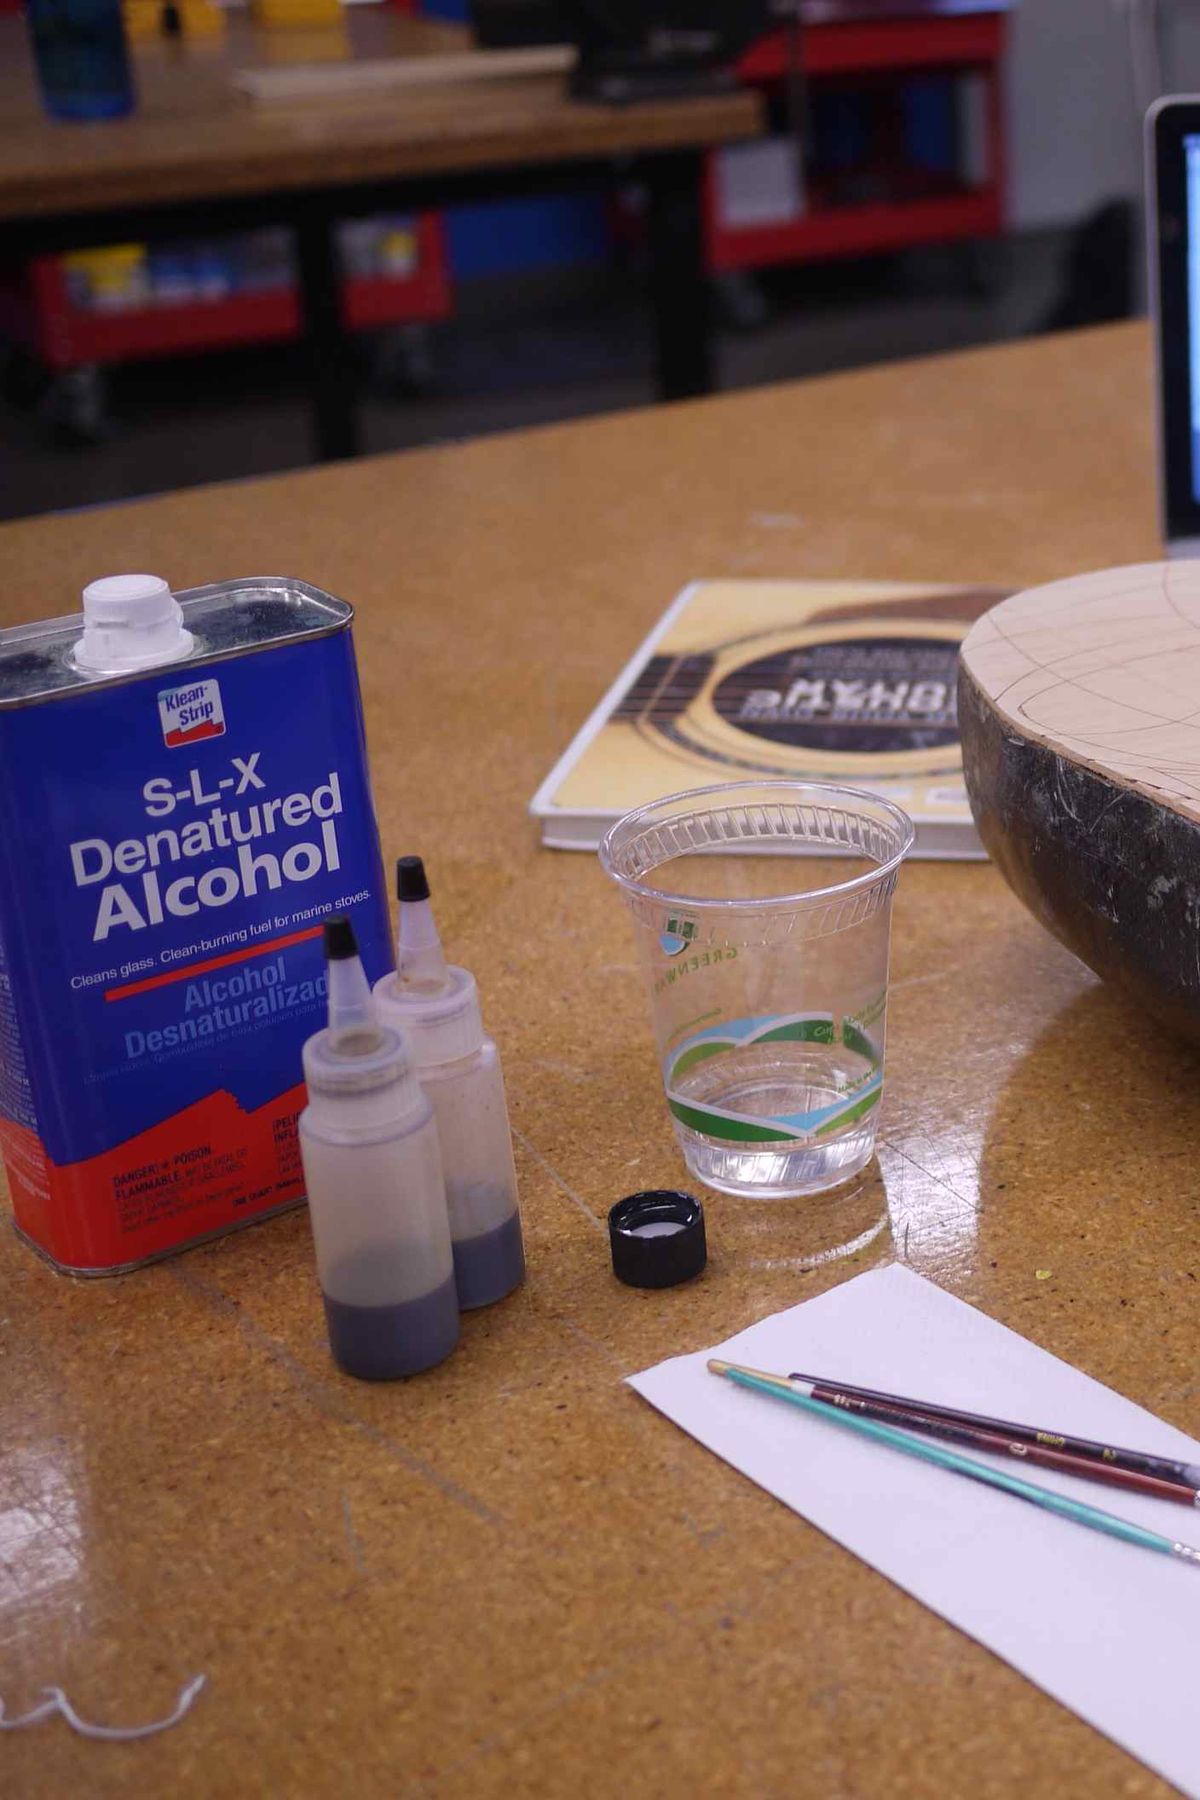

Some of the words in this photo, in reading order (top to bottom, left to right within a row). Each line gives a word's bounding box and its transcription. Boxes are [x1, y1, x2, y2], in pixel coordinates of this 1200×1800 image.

[165, 685, 208, 712] Klean-
[179, 701, 214, 726] Strip
[142, 751, 266, 817] S-L-X
[69, 771, 344, 887] Denatured
[92, 818, 341, 942] Alcohol
[70, 968, 117, 990] Cleans
[120, 957, 157, 979] glass.
[160, 929, 248, 964] Clean-burning
[250, 917, 273, 938] fuel
[274, 913, 290, 929] for
[292, 900, 332, 921] marine
[335, 888, 371, 910] stoves.
[124, 970, 330, 1059] Desnaturalizad
[183, 956, 287, 1012] Alcohol
[173, 1145, 213, 1165] POISON
